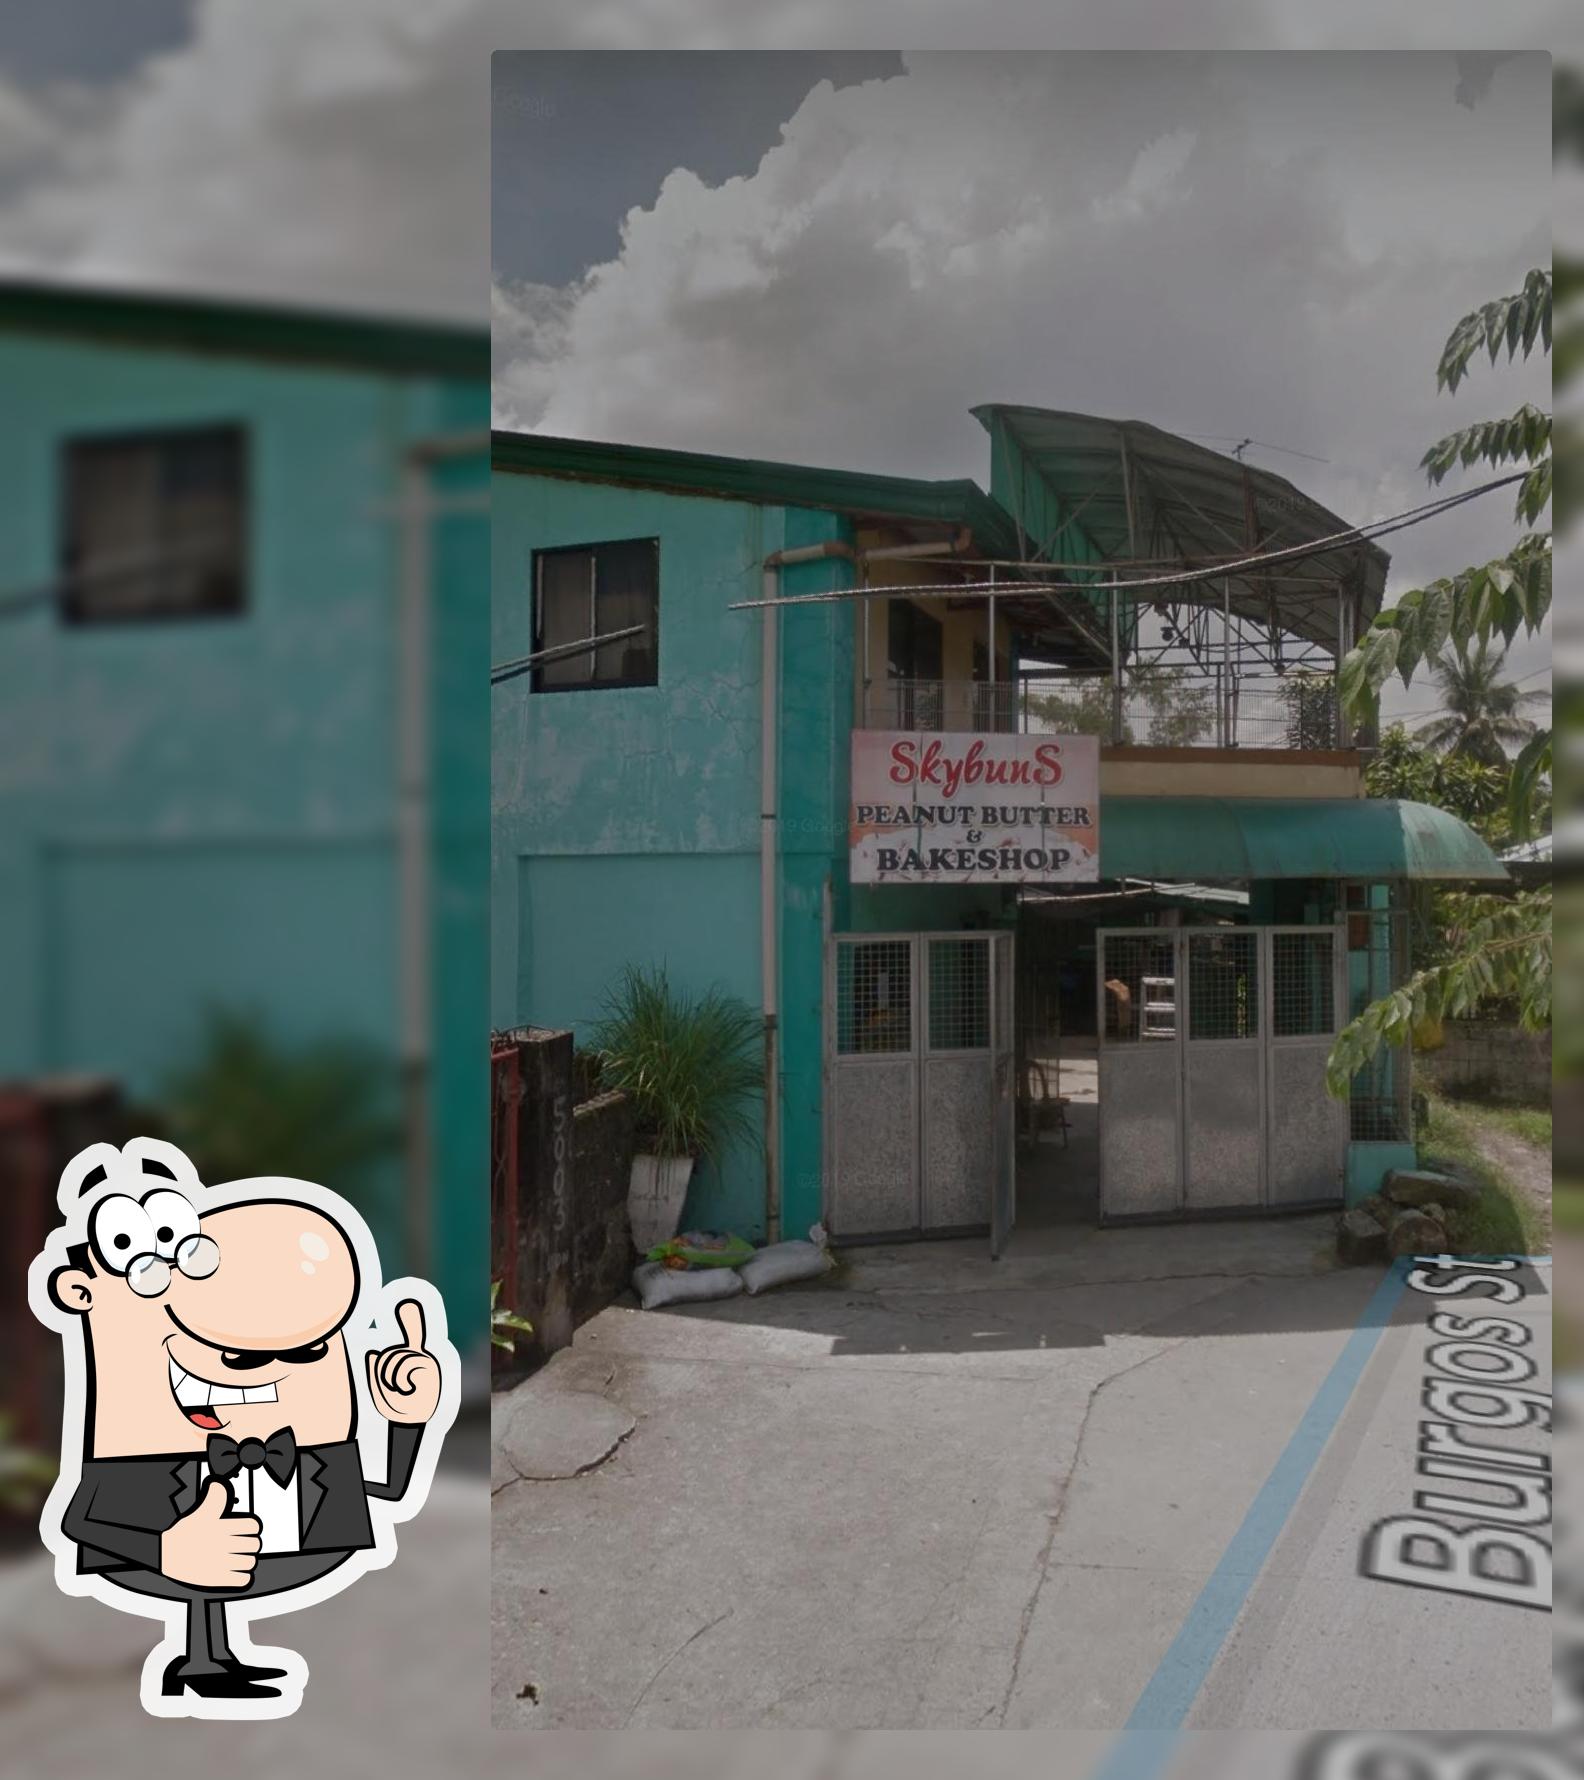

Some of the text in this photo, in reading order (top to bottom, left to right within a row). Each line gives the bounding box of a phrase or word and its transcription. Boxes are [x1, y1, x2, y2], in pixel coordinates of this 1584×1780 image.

[889, 740, 1063, 798] SkybunS
[857, 805, 1090, 825] PEANUT BUTTER
[966, 829, 985, 844] &
[877, 848, 1070, 871] BAKESHOP
